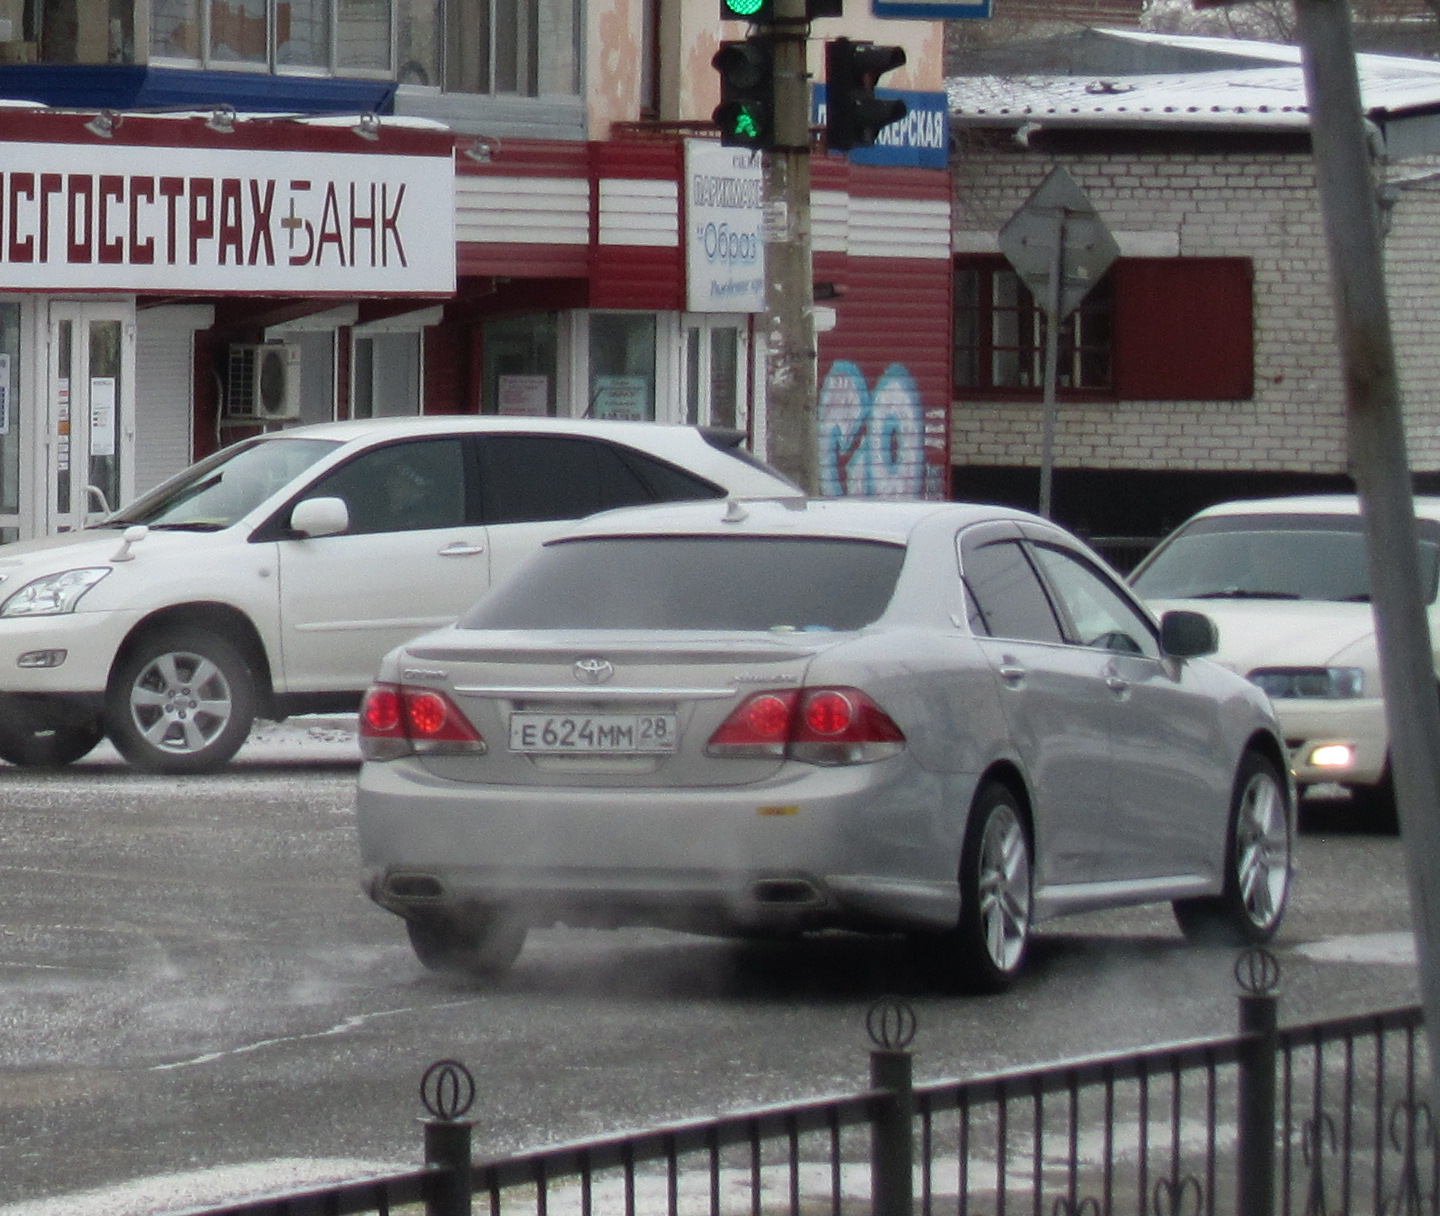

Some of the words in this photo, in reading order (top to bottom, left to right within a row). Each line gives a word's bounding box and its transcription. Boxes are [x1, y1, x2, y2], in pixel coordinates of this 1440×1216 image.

[693, 175, 763, 209] ПАРИКМАХЕ
[522, 716, 633, 747] Е624ММ
[640, 717, 667, 738] 28
